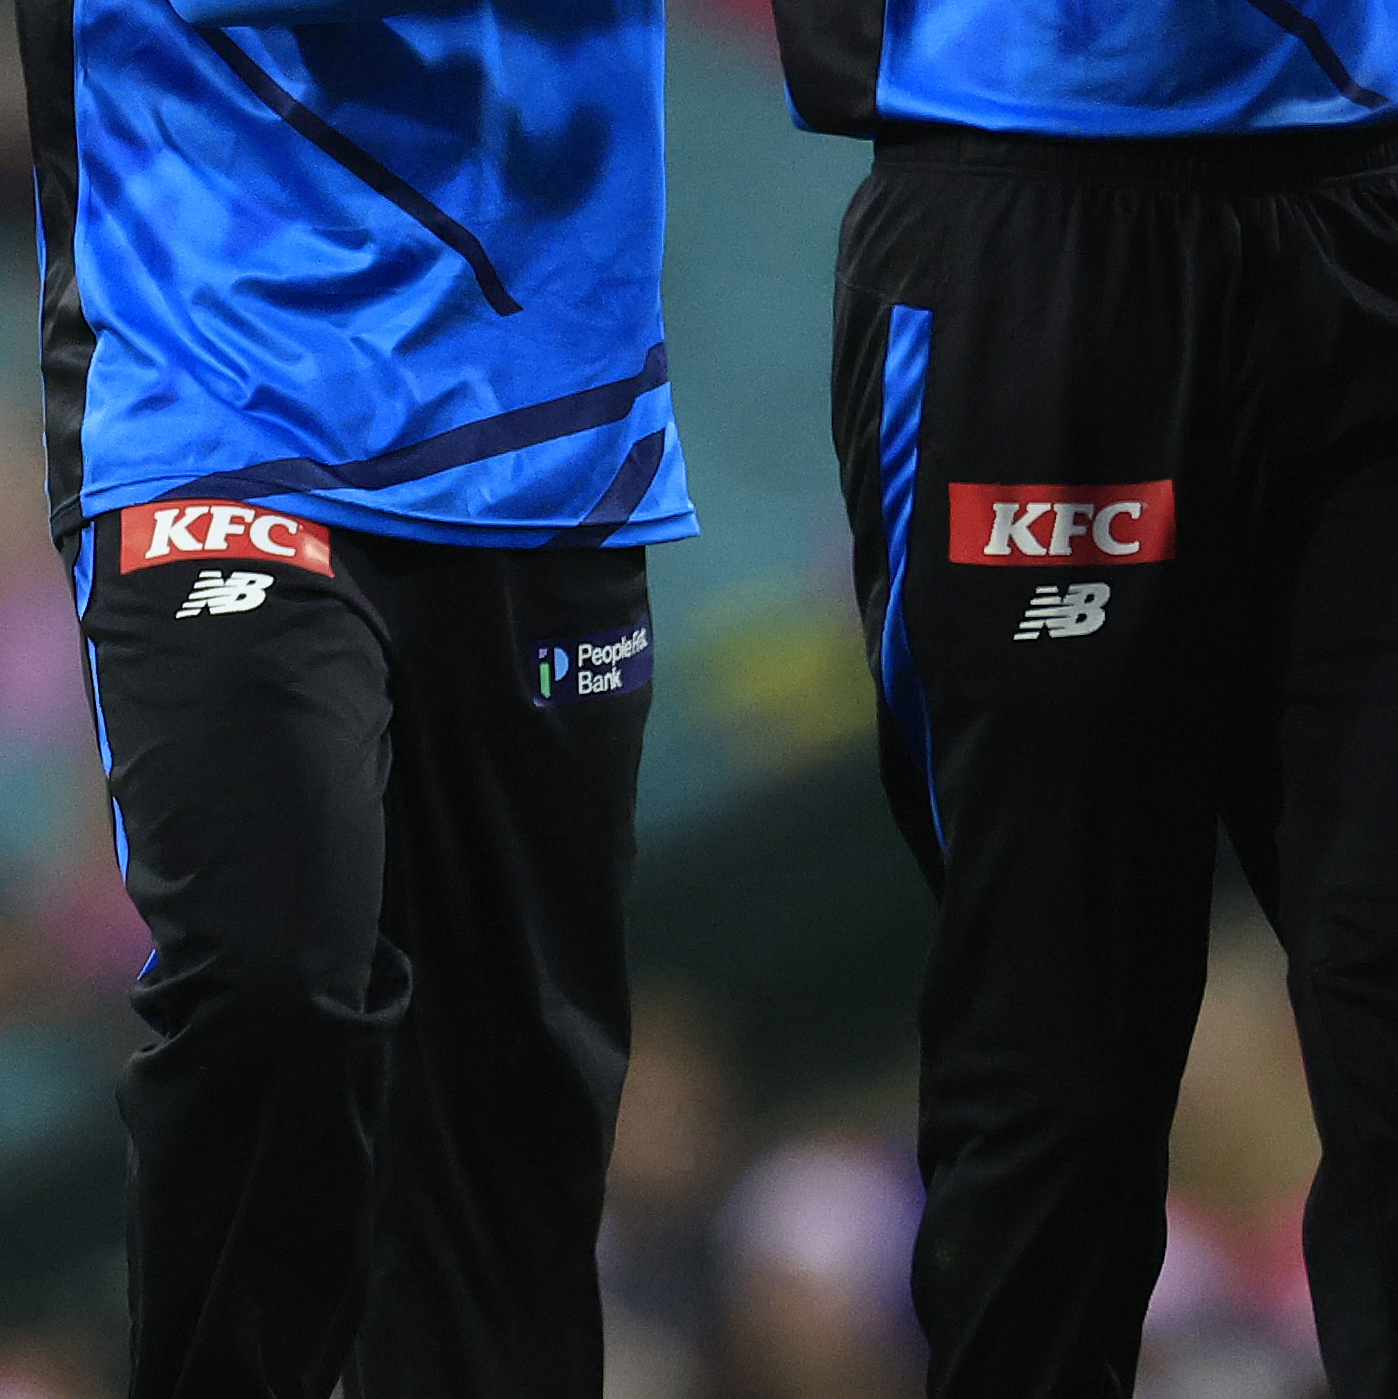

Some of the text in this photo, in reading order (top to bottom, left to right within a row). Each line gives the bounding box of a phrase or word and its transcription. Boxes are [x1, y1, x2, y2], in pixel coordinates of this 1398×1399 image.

[144, 505, 298, 561] KFC
[983, 502, 1141, 557] KFC
[578, 666, 623, 695] Bank
